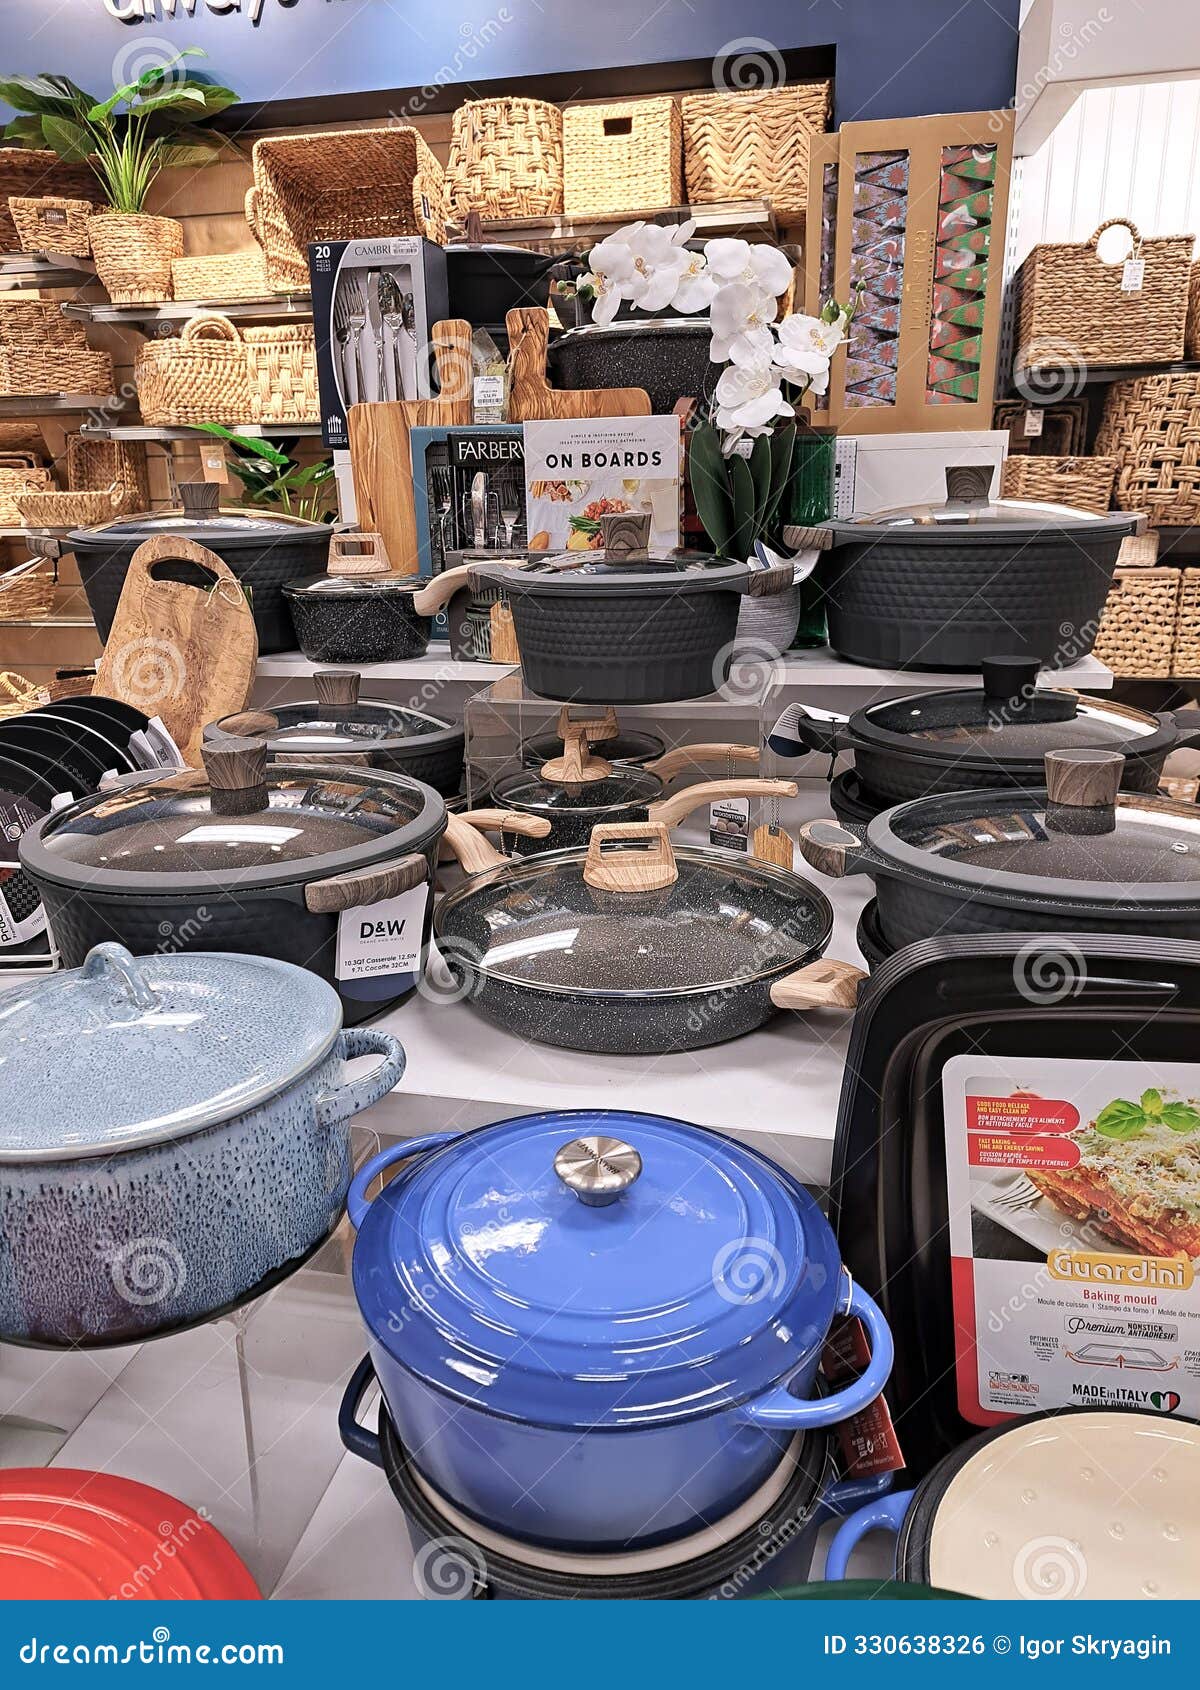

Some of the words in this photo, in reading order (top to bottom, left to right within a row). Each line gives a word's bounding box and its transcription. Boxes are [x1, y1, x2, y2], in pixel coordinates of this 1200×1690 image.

[315, 246, 331, 259] 20
[546, 454, 573, 469] ON
[581, 451, 662, 469] BOARDS
[360, 920, 406, 939] D&W
[365, 964, 390, 972] Cocotte
[366, 955, 397, 964] Casserole
[1053, 1253, 1185, 1286] Guardini
[1083, 1289, 1121, 1304] Baking
[1123, 1294, 1158, 1306] mould
[1037, 1298, 1055, 1306] Moule
[1056, 1299, 1065, 1307] de
[1065, 1300, 1089, 1309] cuisson
[1097, 1303, 1122, 1313] Stampo
[1123, 1305, 1131, 1313] da
[1132, 1306, 1149, 1314] forno
[1157, 1308, 1177, 1317] Molde
[1178, 1310, 1187, 1318] de
[1068, 1317, 1126, 1334] Premium
[1127, 1322, 1163, 1333] NONSTICK
